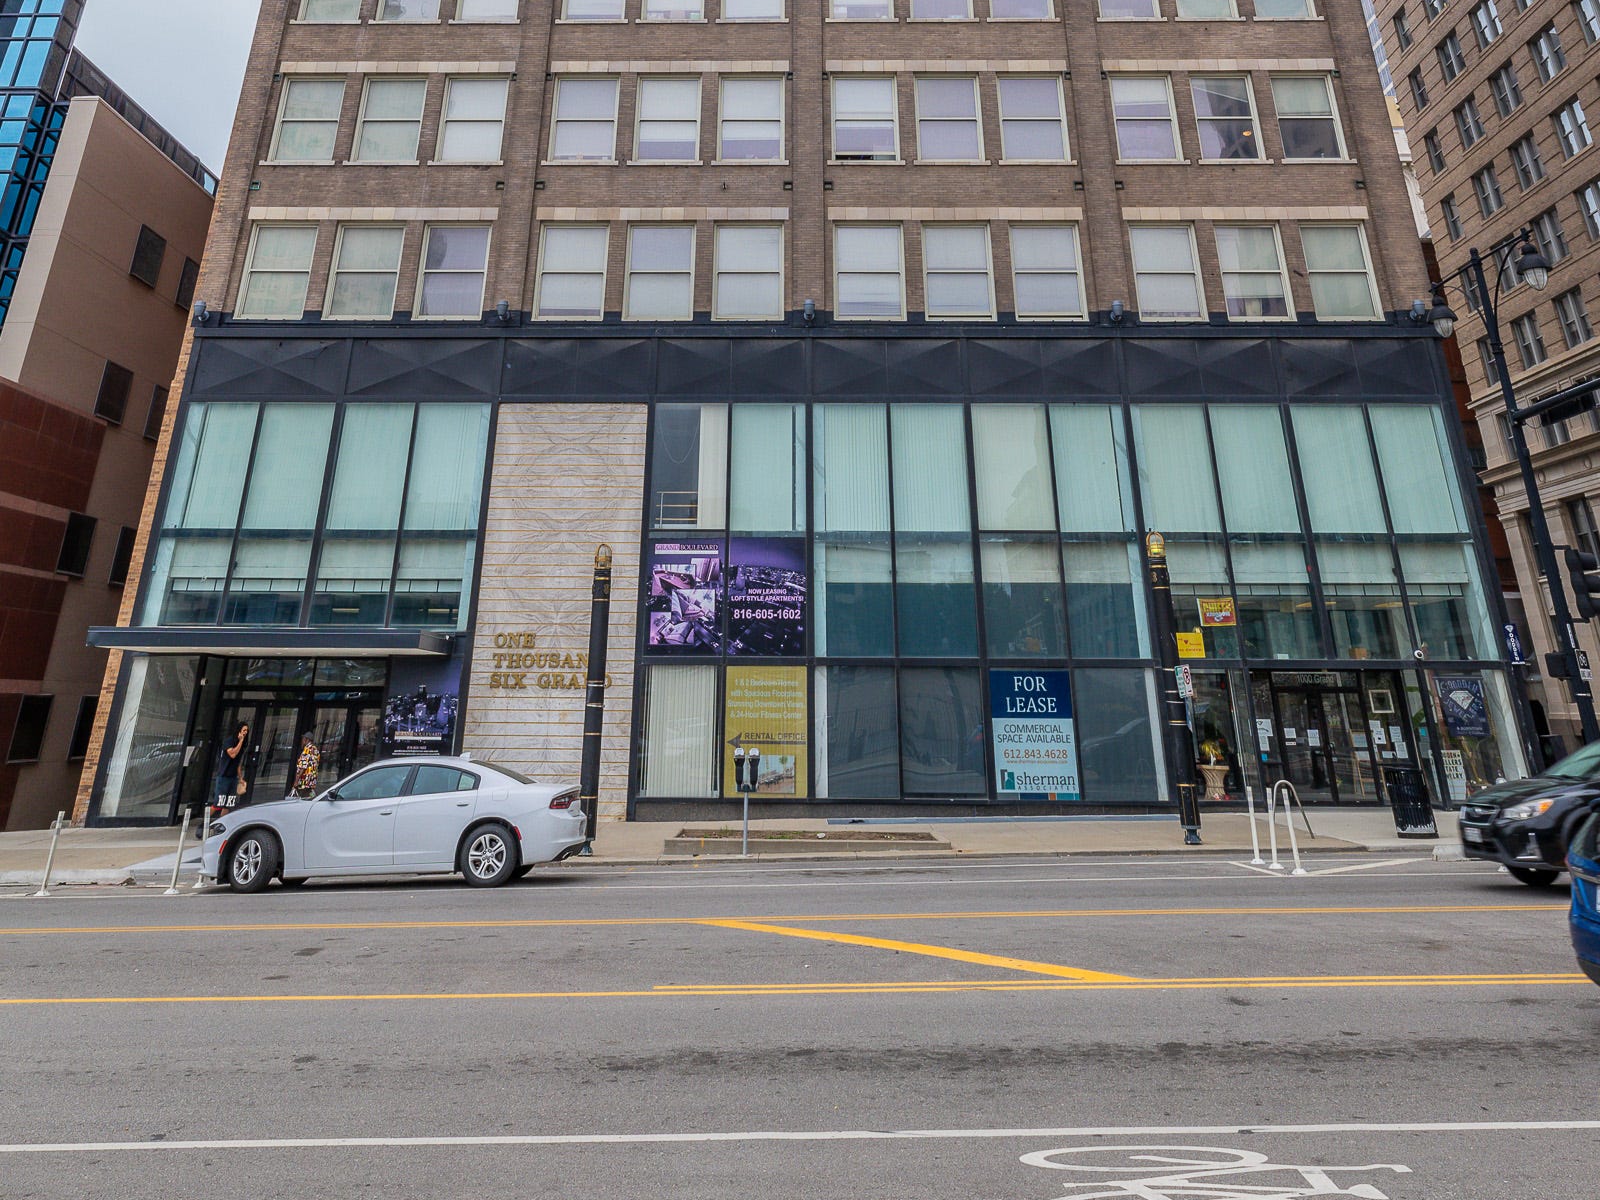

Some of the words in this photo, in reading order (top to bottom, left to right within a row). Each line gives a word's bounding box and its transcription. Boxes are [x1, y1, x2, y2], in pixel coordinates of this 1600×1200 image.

[733, 609, 801, 619] 816-605-1602
[494, 632, 536, 649] ONE
[492, 652, 590, 669] THOUSAN
[489, 672, 527, 689] SIX
[1013, 676, 1048, 692] FOR
[1296, 674, 1312, 683] 1000
[1313, 674, 1334, 683] Grand
[1006, 697, 1057, 713] LEASE
[1004, 724, 1063, 733] COMMERCIAL
[744, 732, 775, 740] RENTAL
[777, 732, 806, 740] OFFICE
[997, 734, 1023, 743] SPACE
[1026, 734, 1071, 743] AVAILABLE
[1003, 749, 1068, 759] 612.843.4628
[1016, 771, 1076, 785] sherman
